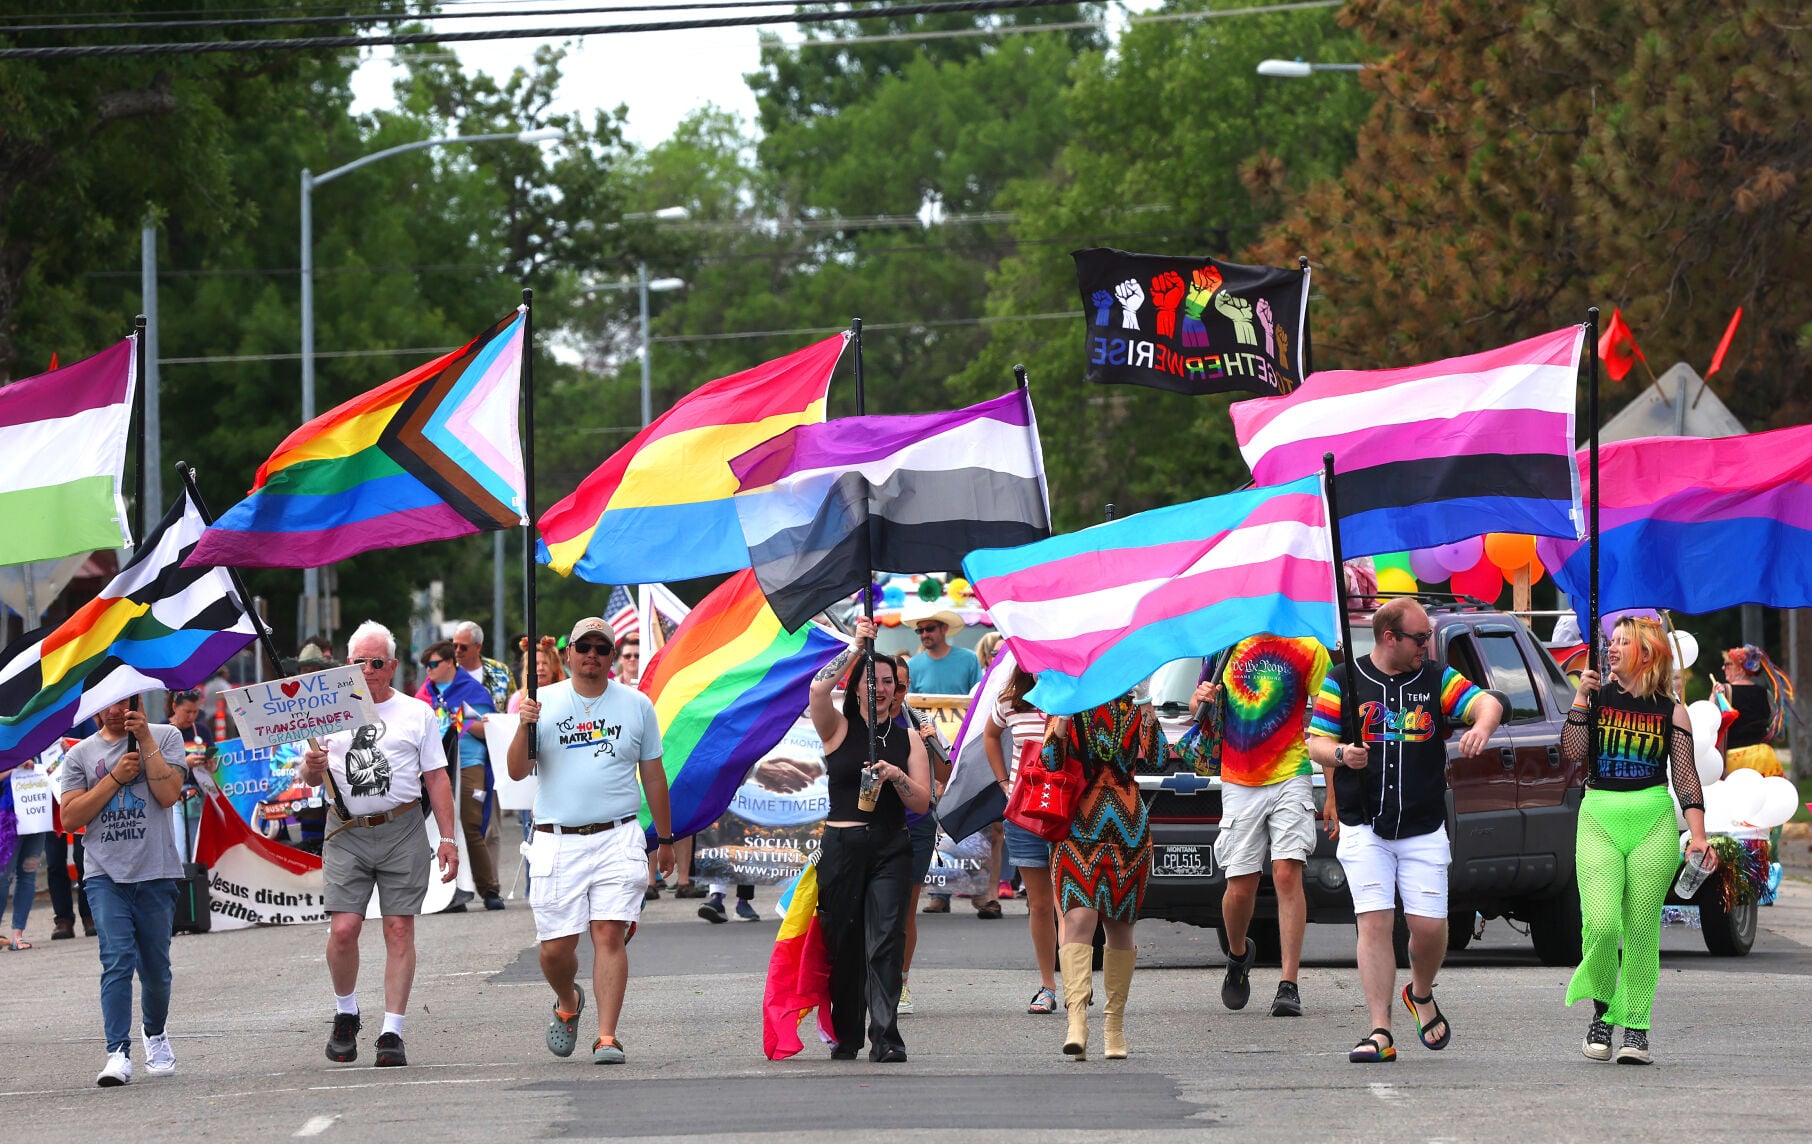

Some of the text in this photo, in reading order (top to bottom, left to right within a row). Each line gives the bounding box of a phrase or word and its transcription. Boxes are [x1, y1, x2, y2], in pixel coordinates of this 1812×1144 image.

[244, 688, 254, 704] I
[337, 676, 355, 689] and
[1407, 692, 1431, 702] TEAM
[263, 691, 339, 716] SUPPORT
[254, 710, 354, 737] TRANSGENDER
[291, 710, 310, 720] my
[1358, 700, 1436, 742] Pride
[1598, 706, 1665, 735] STRAIGHT
[268, 721, 344, 744] GRANDKIDS
[560, 724, 622, 745] MATRIMONY
[576, 718, 606, 733] HOLY
[791, 738, 824, 750] MONTA
[1598, 727, 1662, 764] OUTTA
[213, 750, 247, 773] you
[223, 777, 269, 797] eone
[20, 792, 47, 804] QUEER
[26, 805, 46, 815] LOVE
[101, 808, 146, 824] OHANA
[100, 827, 147, 844] FAMILY
[744, 837, 801, 850] SOCIAL
[701, 848, 730, 860] FOR
[1163, 853, 1201, 869] CPL515
[208, 871, 249, 899] Jesus
[732, 863, 947, 887] www.prim org
[210, 896, 264, 923] either
